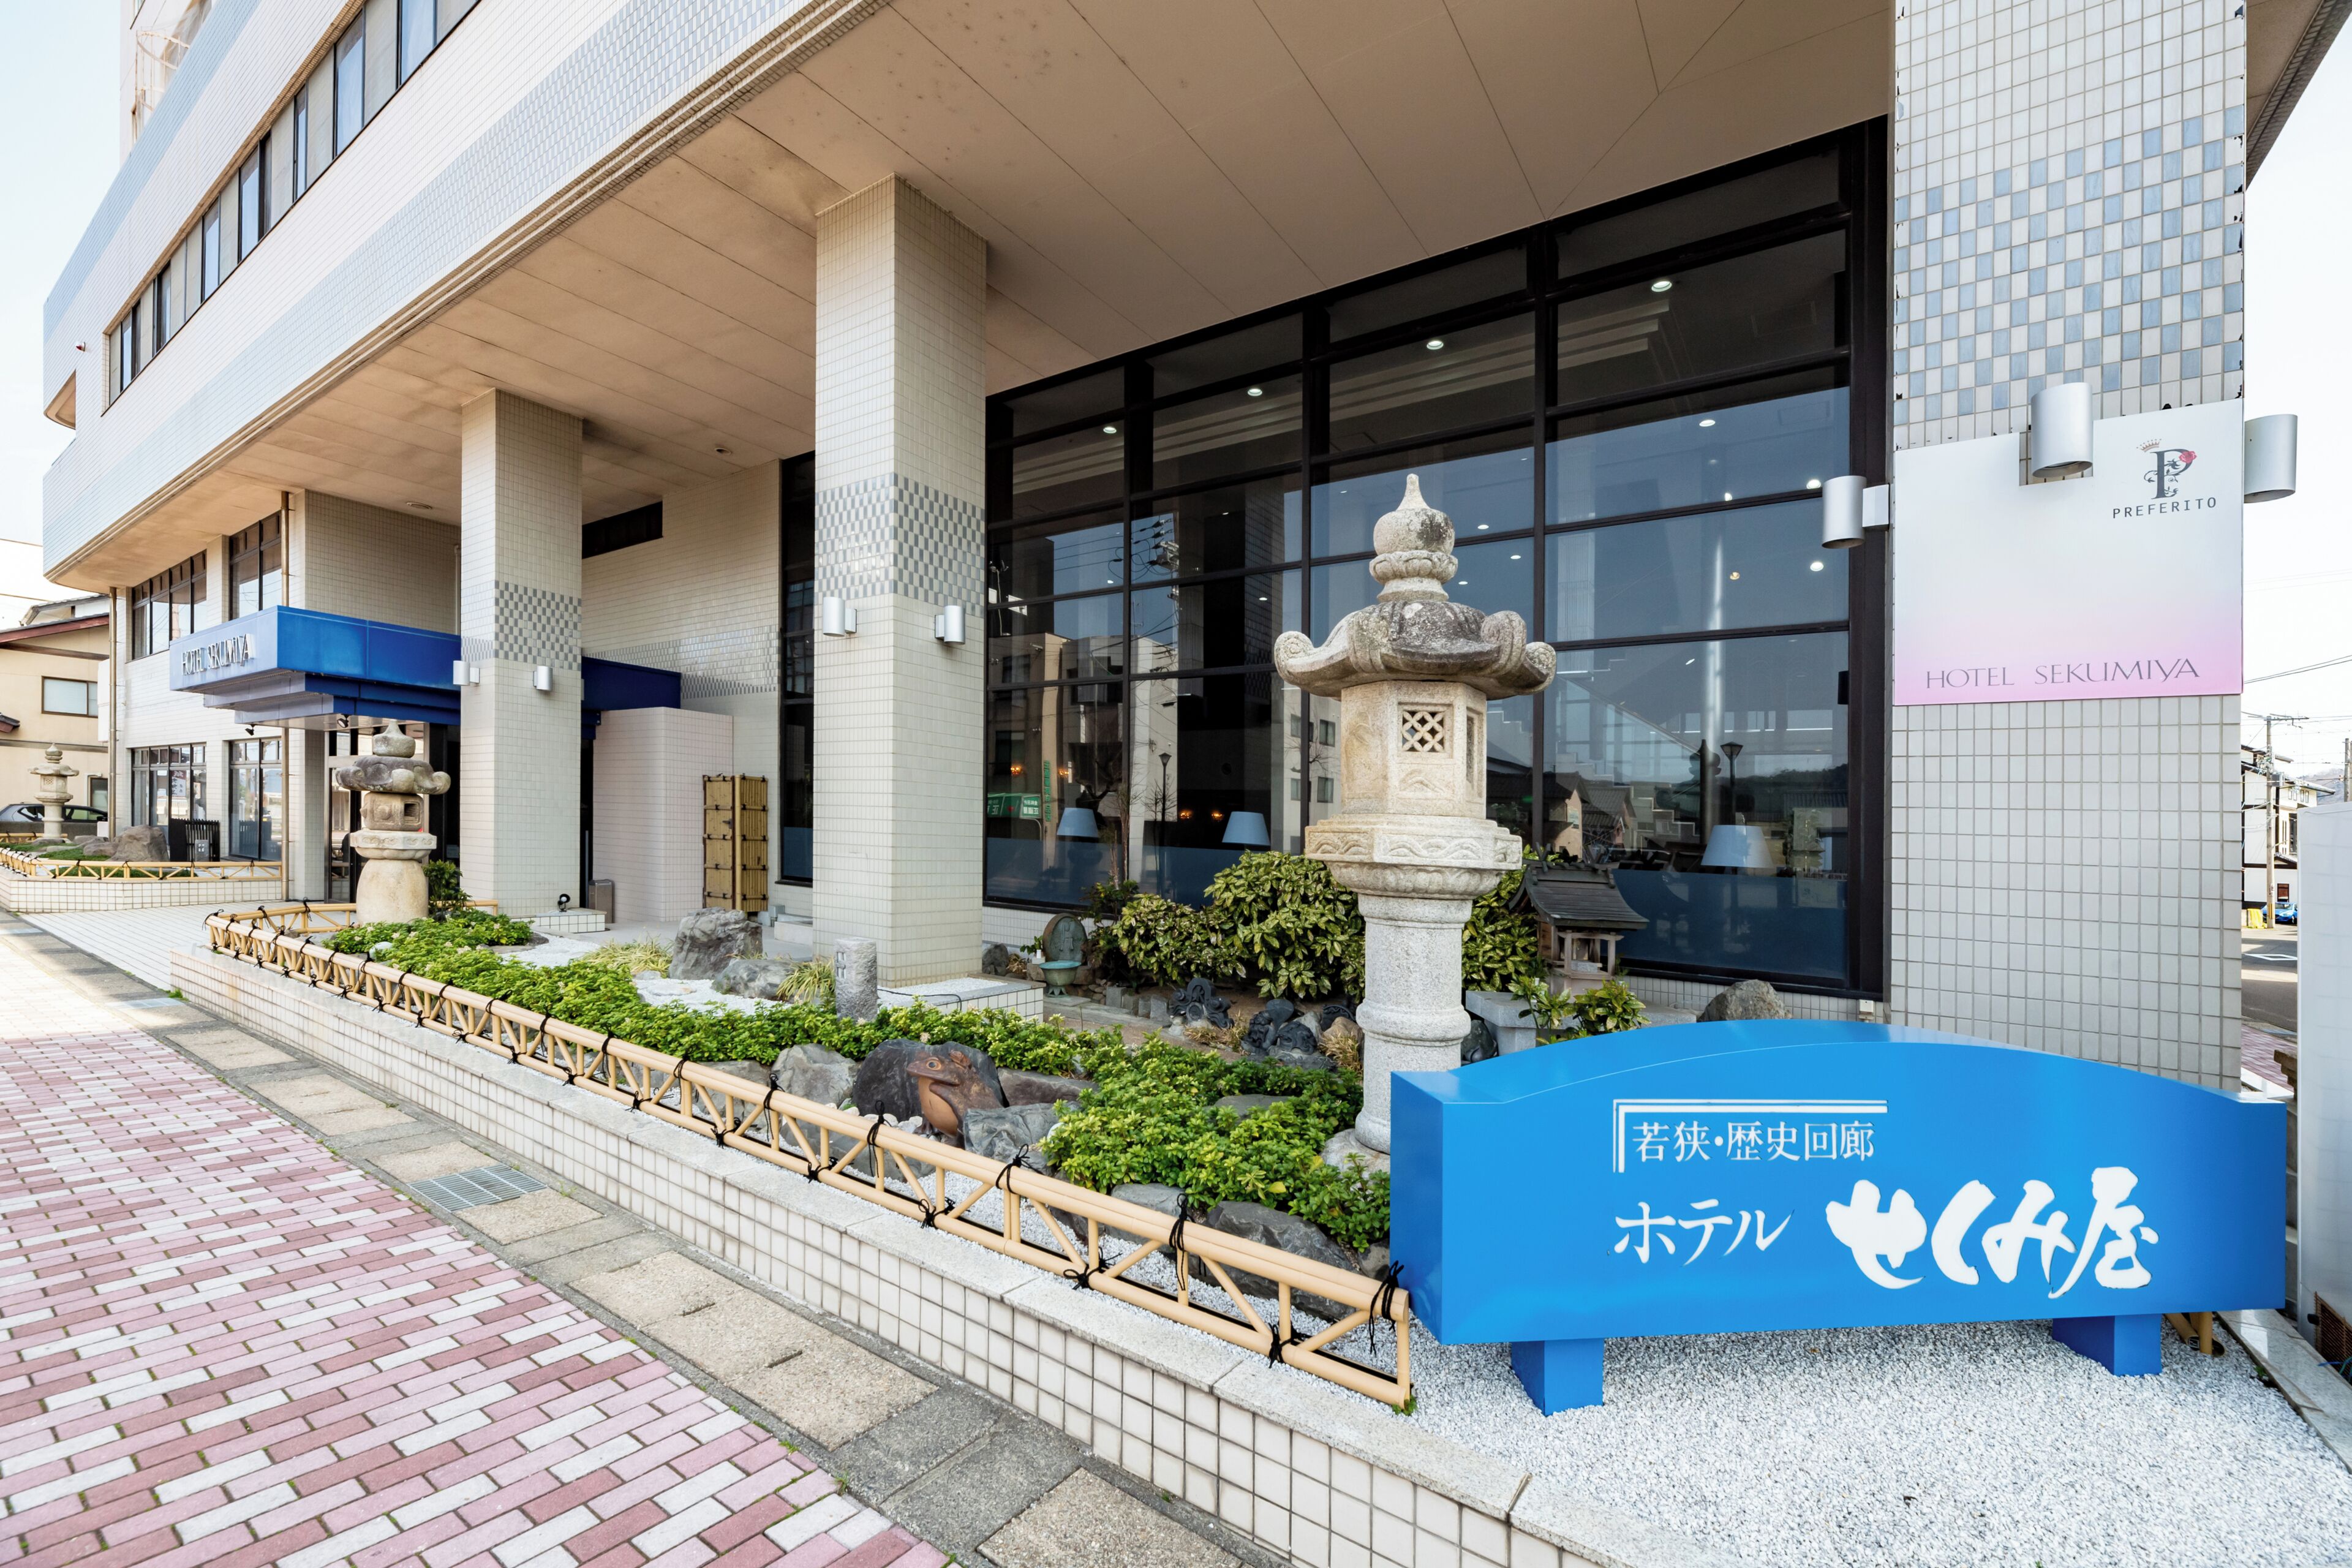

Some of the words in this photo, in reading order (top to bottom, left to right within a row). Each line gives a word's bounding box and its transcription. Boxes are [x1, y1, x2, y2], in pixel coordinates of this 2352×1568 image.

[2113, 497, 2217, 519] PREFERITO
[182, 647, 205, 676] HOTEL
[207, 633, 252, 669] SEKUMIYA
[1926, 667, 2015, 688] HOTEL
[2035, 658, 2200, 684] SEKUMIYA
[1633, 1120, 1875, 1162] 若狭・歴史回廊
[1613, 1198, 1795, 1265] ホテル
[1826, 1166, 2158, 1298] せくみ屋
